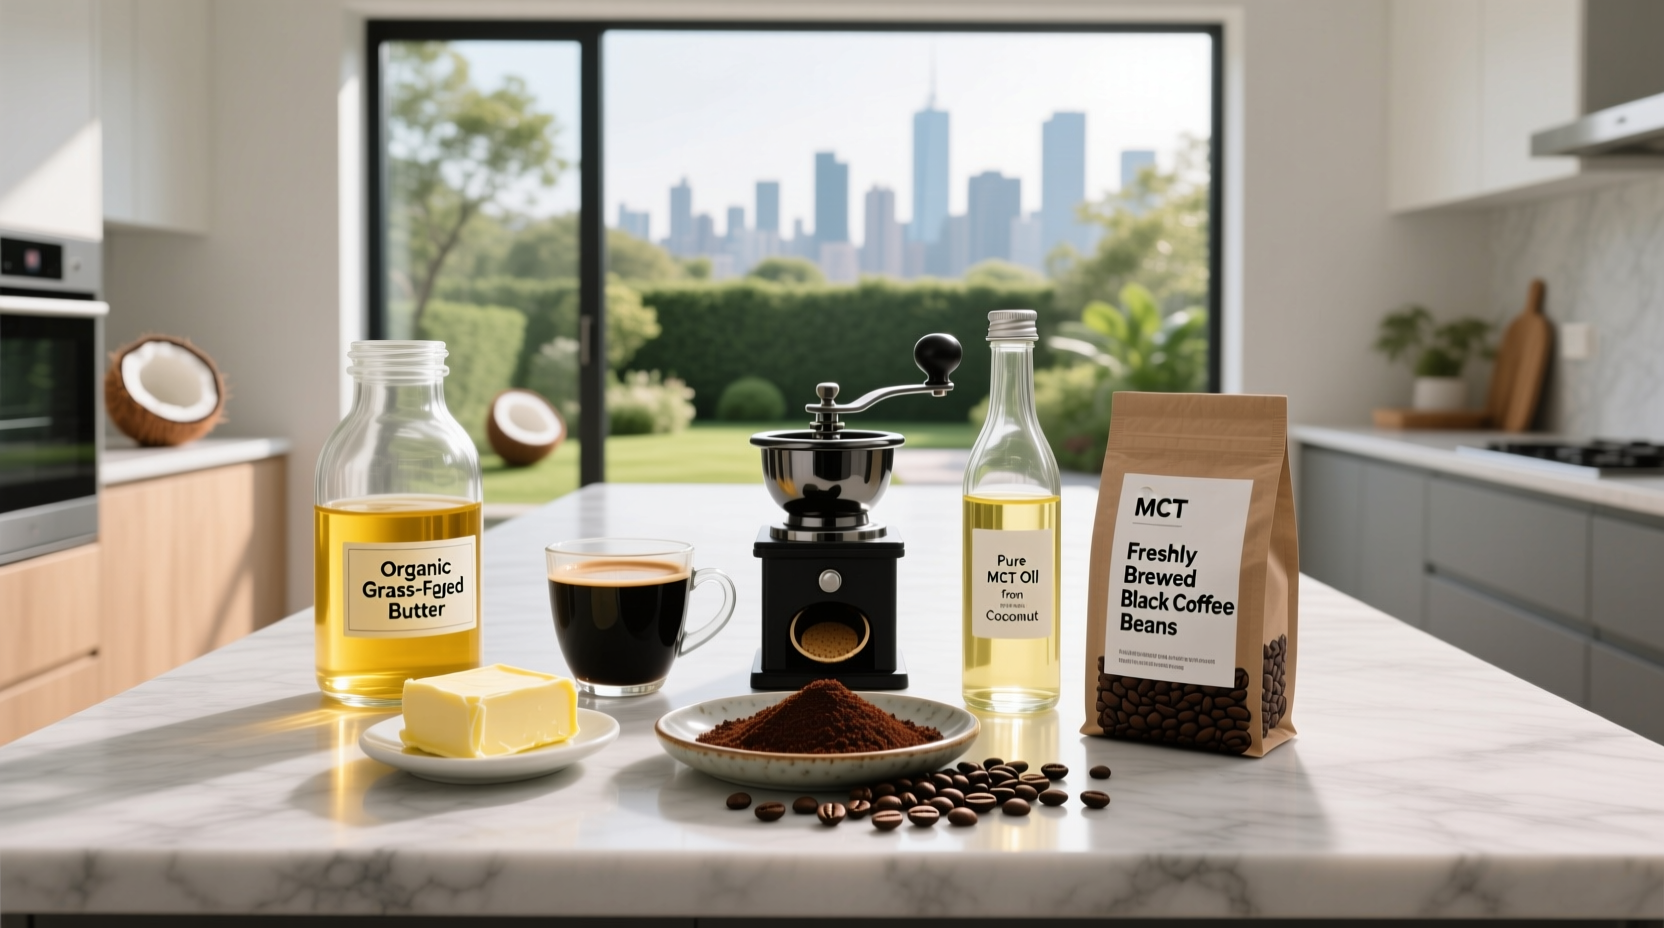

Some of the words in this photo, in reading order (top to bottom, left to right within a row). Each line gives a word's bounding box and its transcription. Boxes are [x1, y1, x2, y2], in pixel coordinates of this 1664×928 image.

[1135, 497, 1189, 519] MCT
[997, 554, 1027, 567] Pure
[1127, 542, 1198, 568] Freshly
[380, 558, 451, 582] Organic
[987, 571, 1017, 584] MCT
[1124, 565, 1197, 588] Brewed
[388, 602, 446, 620] Butter
[1121, 589, 1169, 612] Black
[1172, 593, 1235, 616] Coffee
[1120, 612, 1178, 636] Beans
